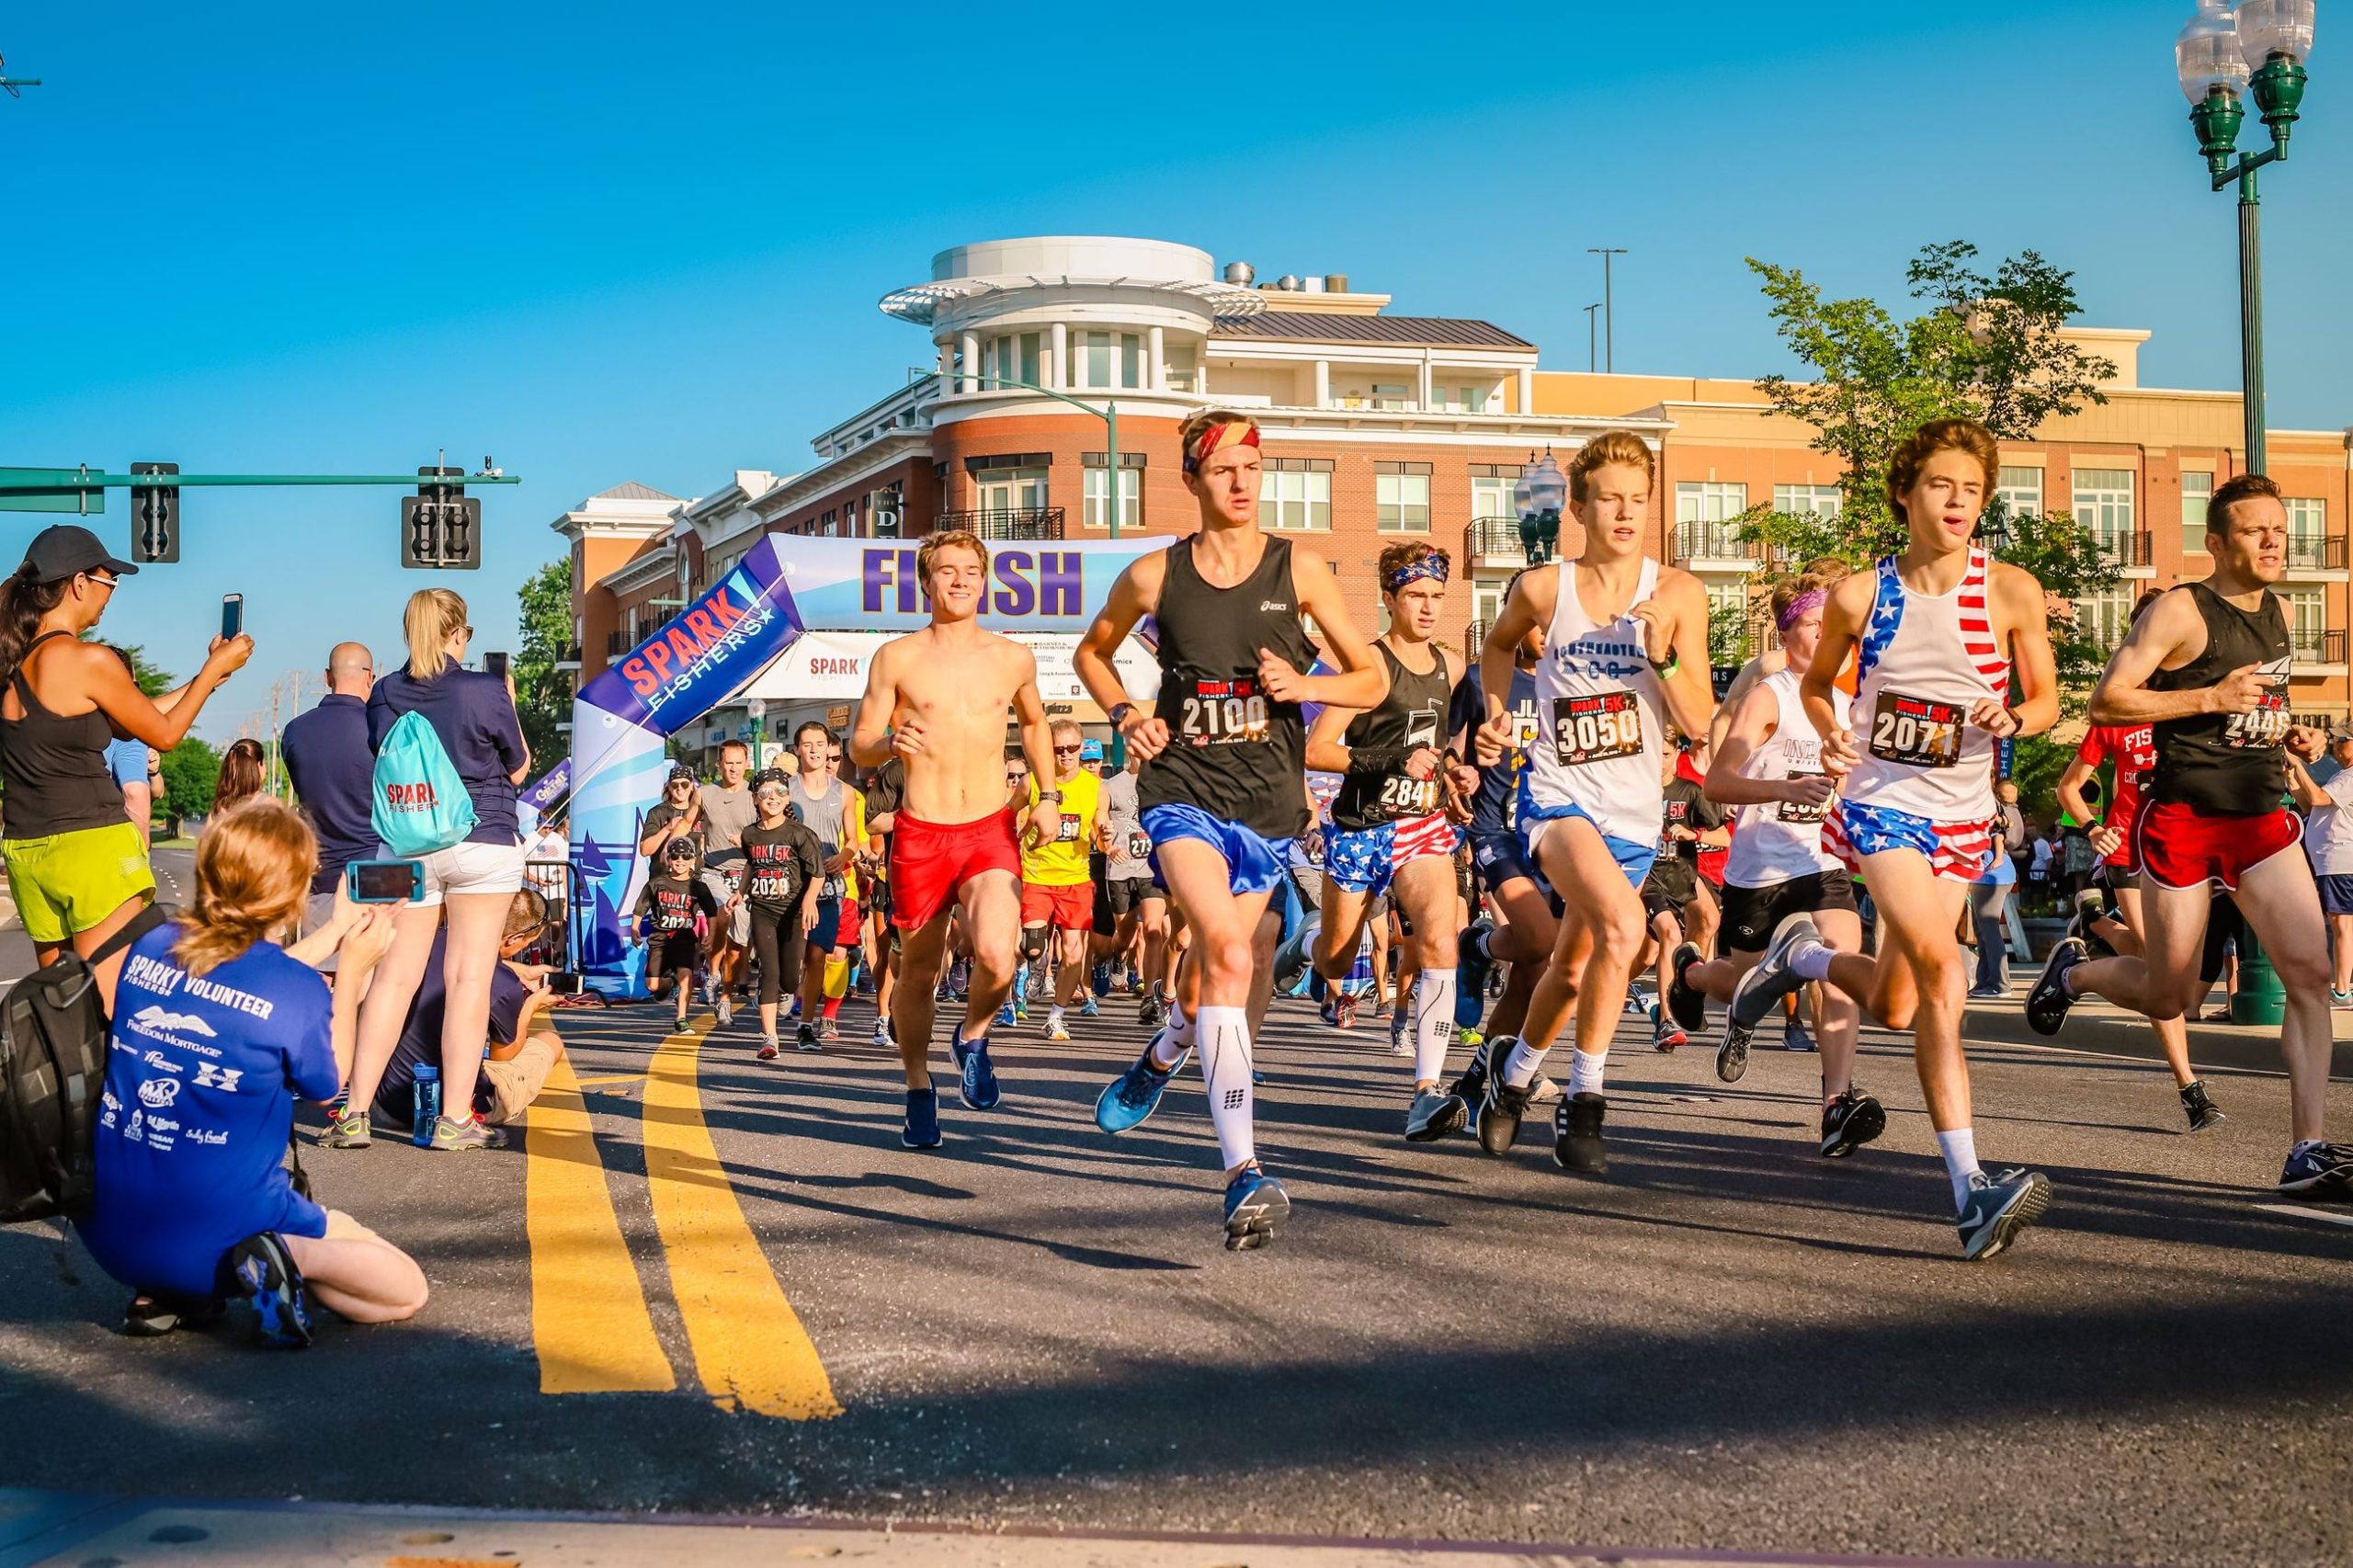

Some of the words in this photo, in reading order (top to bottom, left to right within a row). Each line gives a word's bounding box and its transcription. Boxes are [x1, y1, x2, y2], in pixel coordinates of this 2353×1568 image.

[863, 549, 1083, 616] FISH
[1183, 696, 1266, 734] 2100
[1605, 695, 1625, 713] 5K
[1557, 710, 1639, 753] 3050
[1873, 712, 1956, 756] 2071
[1381, 778, 1435, 809] 2841
[1669, 801, 1687, 817] 5K
[775, 845, 791, 861] 5K
[658, 892, 686, 906] PARK!
[123, 973, 167, 995] FISHERS
[127, 955, 186, 992] SPARK!
[184, 976, 274, 1020] VOLUNTEER
